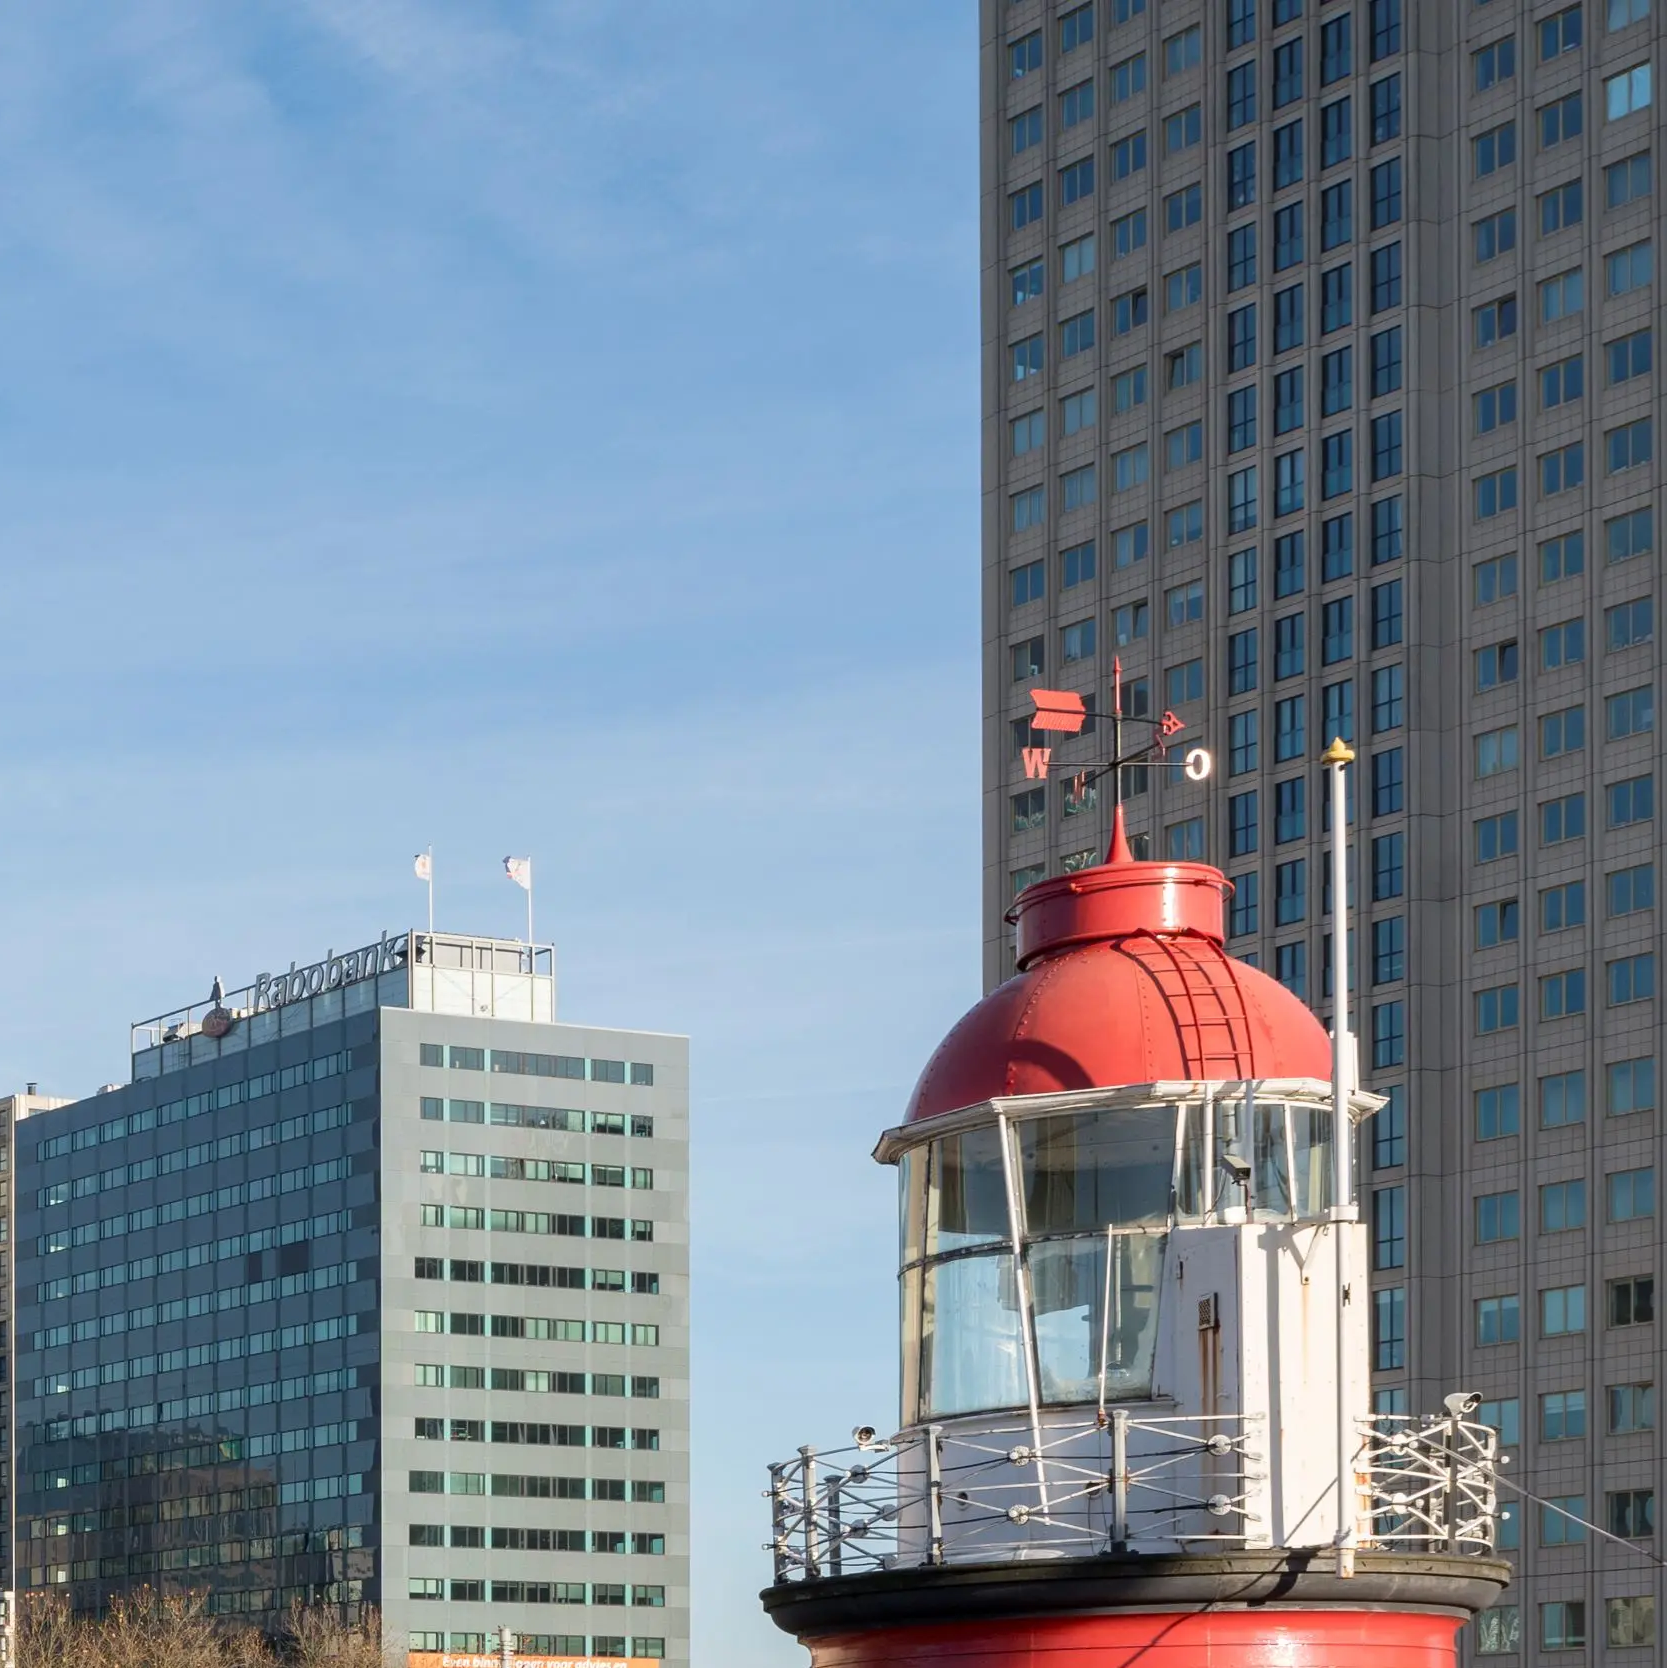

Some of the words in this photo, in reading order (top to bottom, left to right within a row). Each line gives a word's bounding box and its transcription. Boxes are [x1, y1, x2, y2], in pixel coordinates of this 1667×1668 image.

[1022, 748, 1052, 779] W
[1185, 748, 1211, 781] O
[253, 930, 398, 1015] Rabobank
